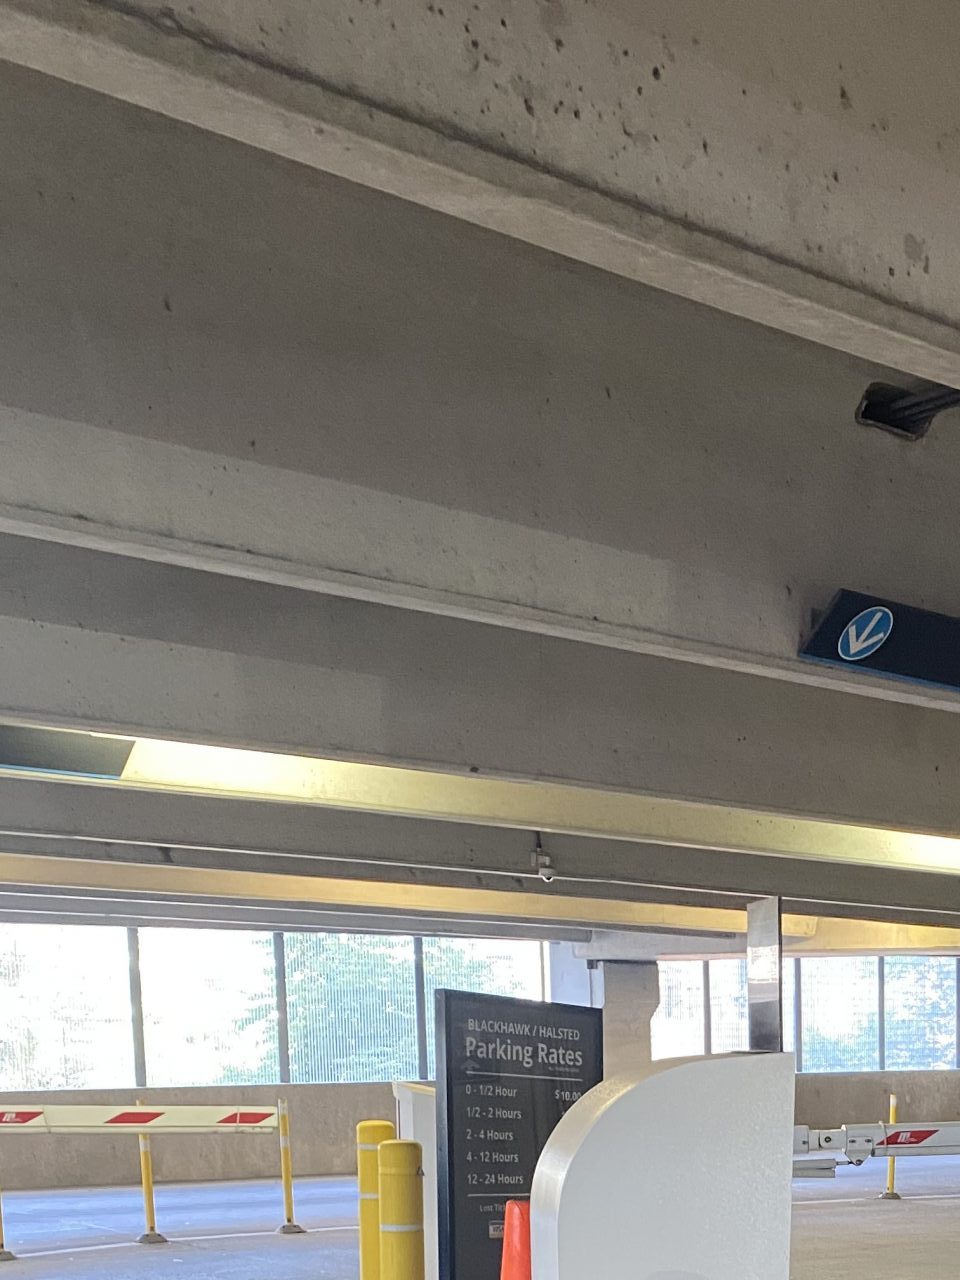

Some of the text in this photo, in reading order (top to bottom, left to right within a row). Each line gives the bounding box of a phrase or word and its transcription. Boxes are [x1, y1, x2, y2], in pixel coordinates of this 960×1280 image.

[468, 1018, 531, 1036] BLACKHAWK
[539, 1026, 580, 1040] HALSTED
[465, 1036, 583, 1068] Parking Rates
[465, 1084, 472, 1095] 0
[480, 1084, 493, 1096] 1/2
[495, 1086, 518, 1097] Hour
[467, 1107, 481, 1118] 1/2
[488, 1107, 494, 1118] 2
[495, 1108, 522, 1119] Hours
[466, 1128, 472, 1140] 2
[479, 1128, 485, 1139] 4
[486, 1129, 514, 1141] Hours
[466, 1151, 472, 1162] 4
[480, 1151, 490, 1162] 12
[492, 1152, 519, 1163] Hours
[467, 1174, 478, 1184] 12
[484, 1174, 495, 1184] 24
[497, 1174, 524, 1184] Hours
